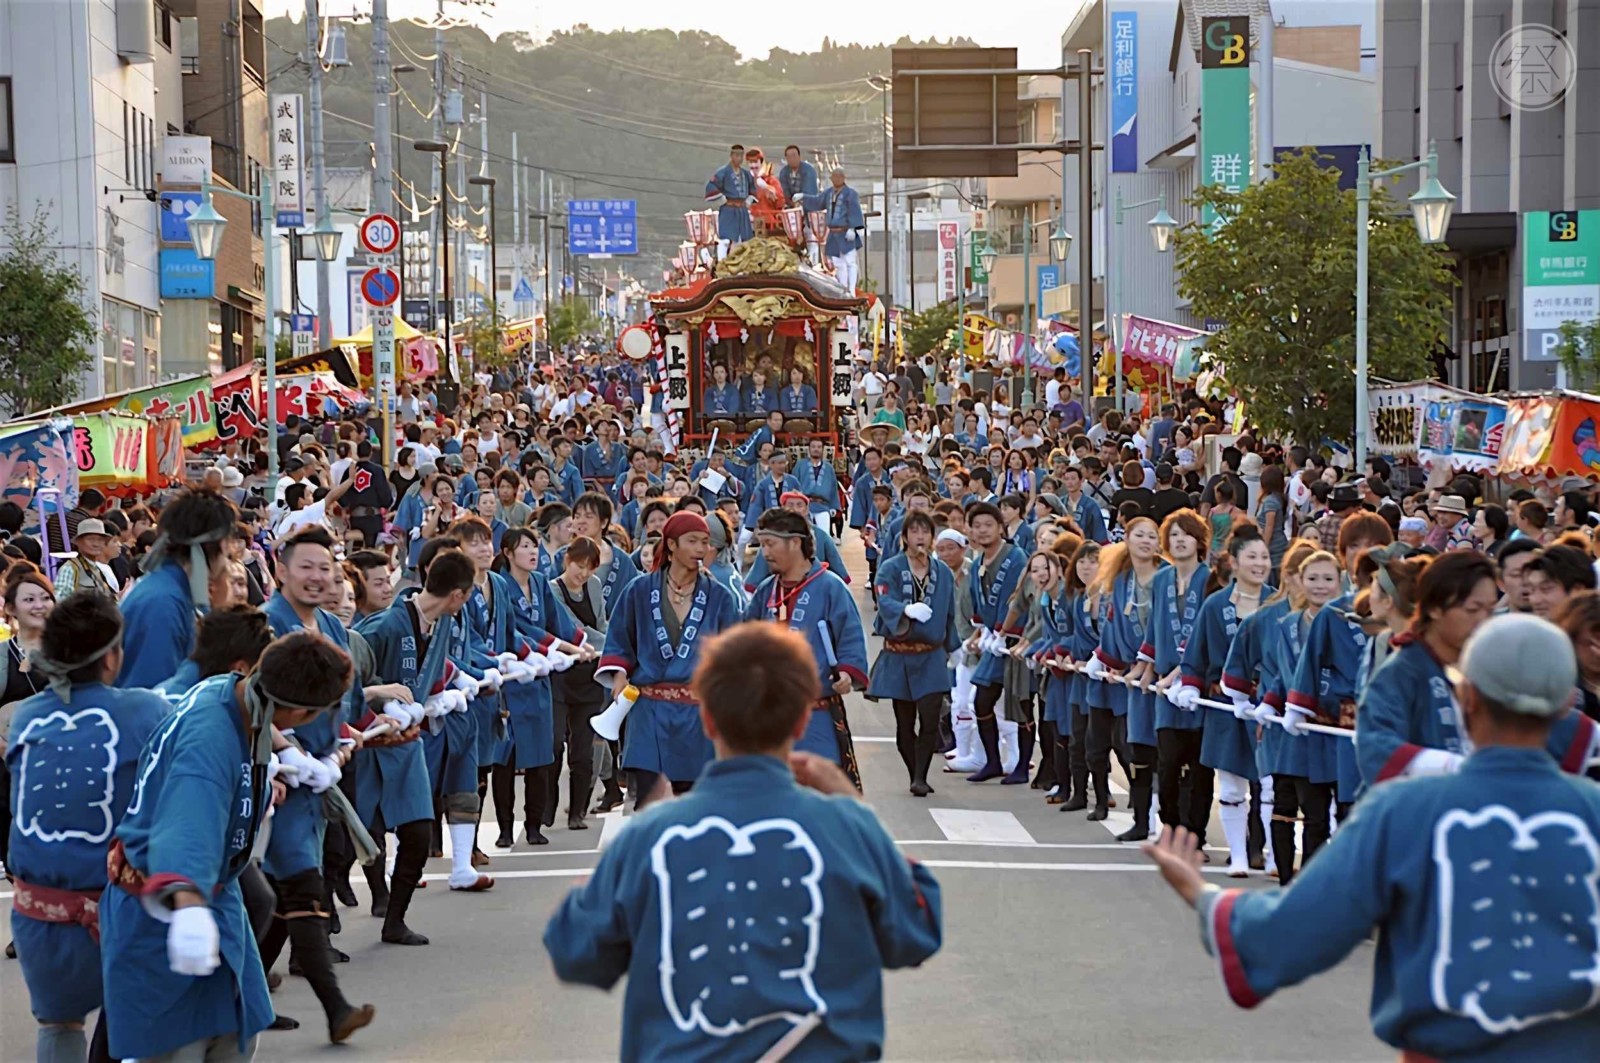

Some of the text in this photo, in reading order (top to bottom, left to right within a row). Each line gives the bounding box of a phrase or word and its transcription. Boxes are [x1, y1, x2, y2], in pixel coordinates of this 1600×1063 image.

[1115, 20, 1134, 96] 足利銀行
[1205, 20, 1246, 65] GB
[168, 156, 205, 164] ALBION
[276, 101, 296, 197] 武蔵学院
[369, 225, 392, 243] 30
[1551, 213, 1576, 240] GB
[297, 316, 309, 330] P
[1130, 326, 1178, 360] タピオカ
[1541, 332, 1559, 356] P
[669, 346, 687, 400] 上郷
[832, 342, 852, 397] 上郷
